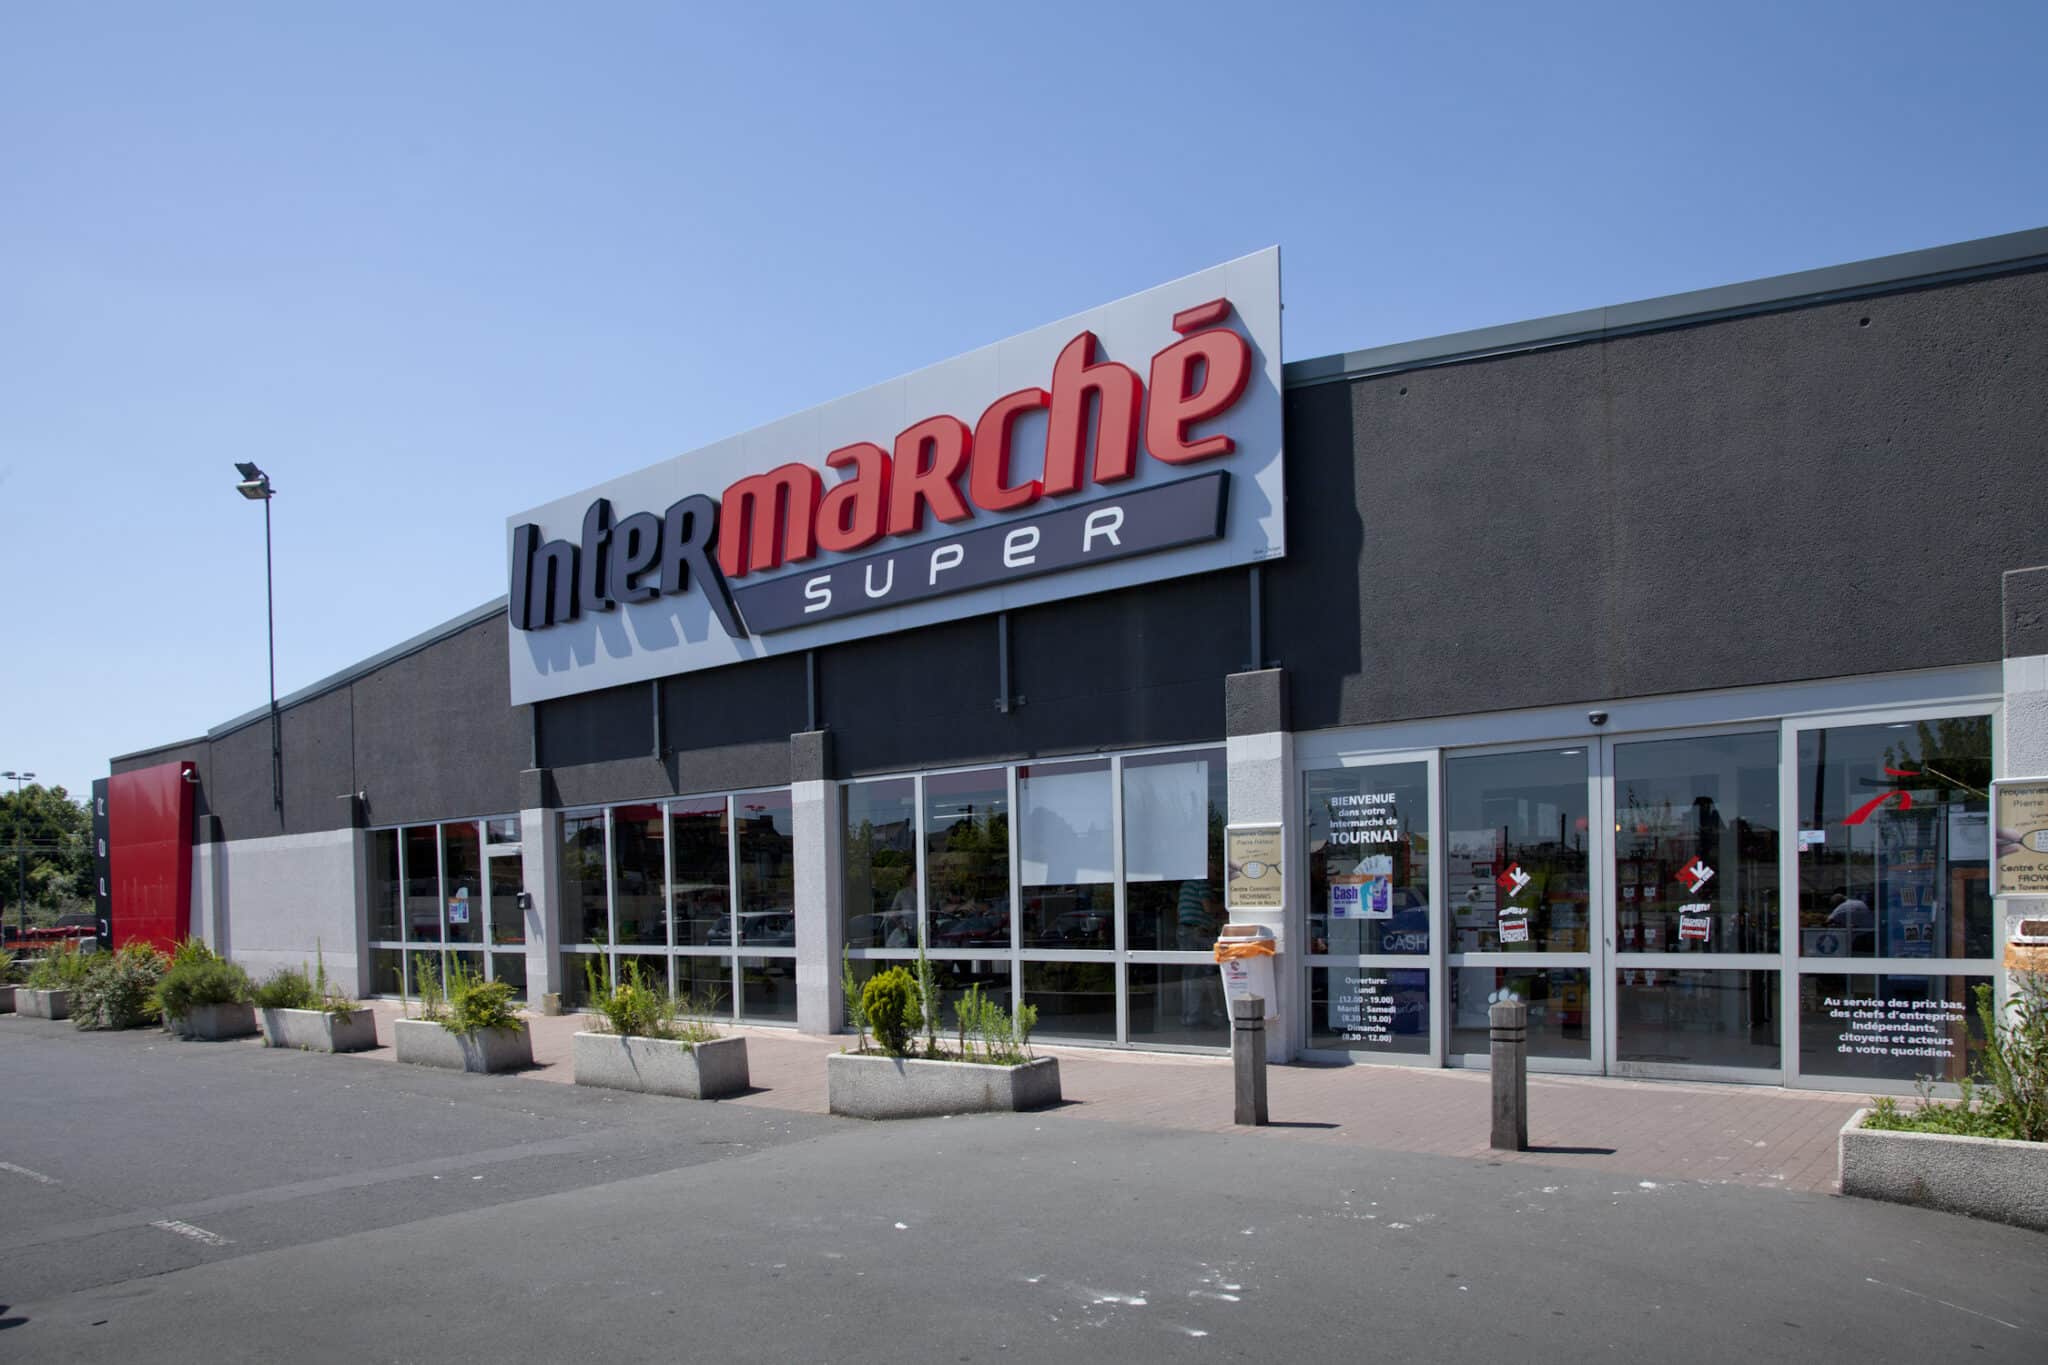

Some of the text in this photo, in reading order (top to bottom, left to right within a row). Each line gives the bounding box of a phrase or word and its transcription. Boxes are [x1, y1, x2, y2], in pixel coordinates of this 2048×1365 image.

[1331, 793, 1396, 807] BIENVENUE
[1338, 807, 1386, 817] dans votre
[1386, 816, 1398, 825] de
[1330, 829, 1398, 845] TOURNAI
[1333, 886, 1358, 900] Cash
[1383, 934, 1428, 951] CASH
[1345, 977, 1387, 985] Ouverture:
[1354, 986, 1376, 994] Lundi
[1824, 997, 1966, 1010] Au service des prix bas,
[1829, 1009, 1850, 1018] des
[1852, 1010, 1885, 1020] chefs
[1347, 1024, 1387, 1033] Dimanche
[1839, 1032, 1954, 1046] citoyens et acteurs
[1838, 1044, 1955, 1058] de votre quotidien.
